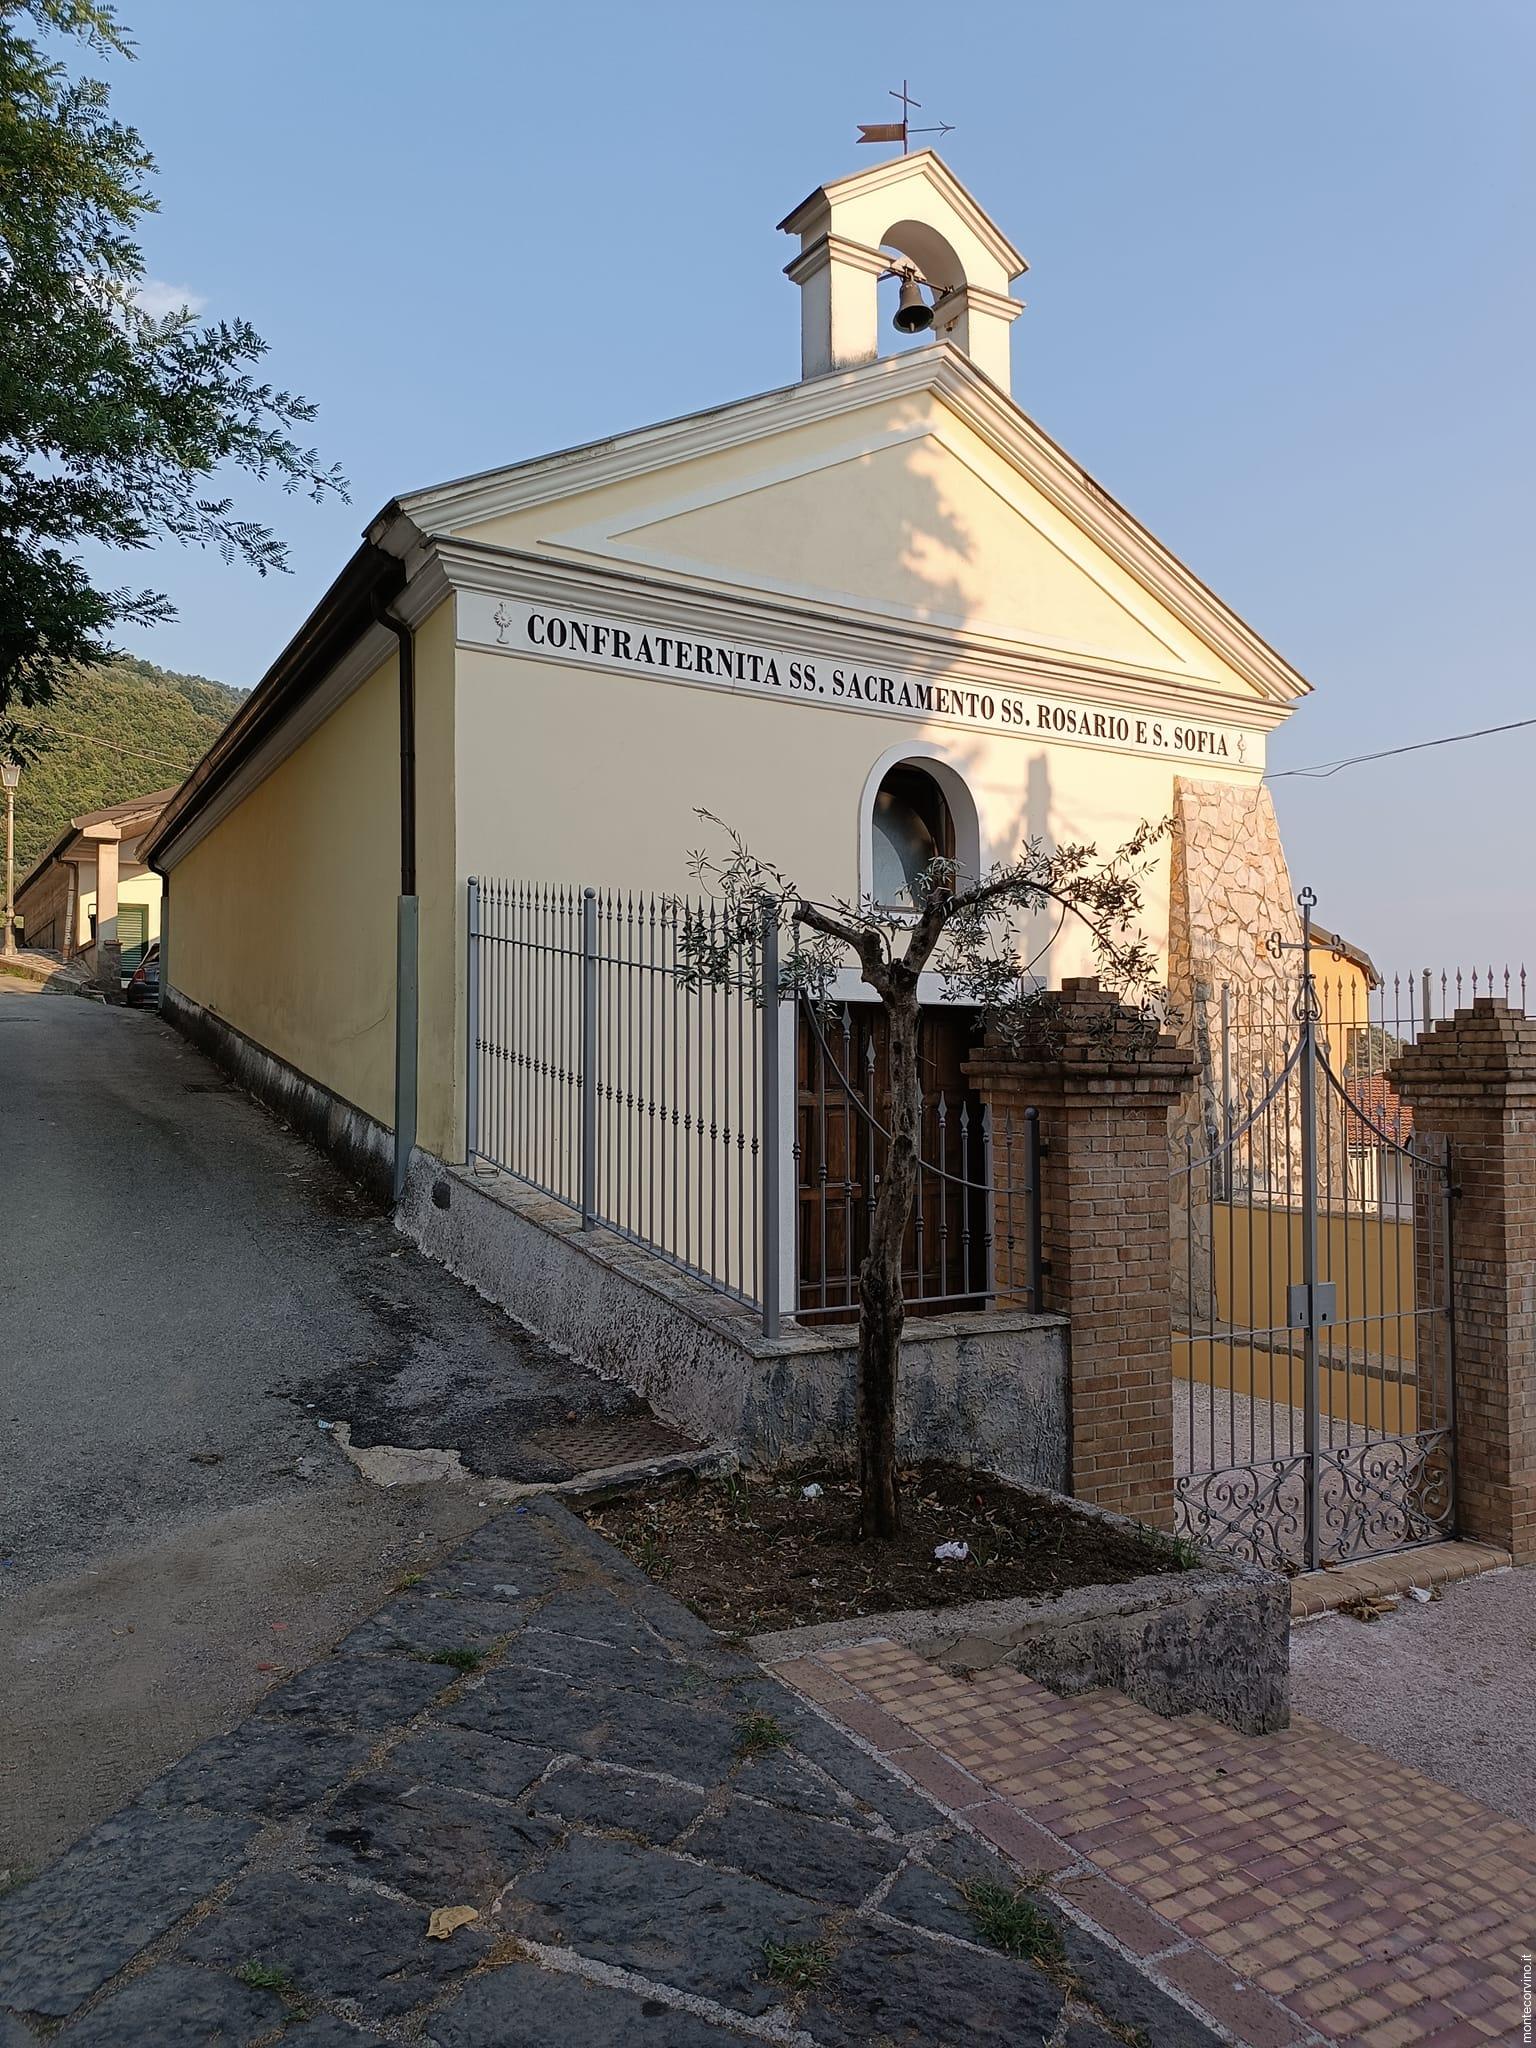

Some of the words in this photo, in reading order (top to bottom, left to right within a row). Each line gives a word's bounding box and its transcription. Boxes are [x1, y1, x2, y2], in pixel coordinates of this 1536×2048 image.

[527, 614, 782, 686] CONFRATERNITA
[789, 662, 825, 694] SS.
[832, 669, 994, 720] SACRAMENTO
[1001, 699, 1030, 727] SS.
[1037, 704, 1129, 742] ROSARIO
[1135, 721, 1148, 744] E
[1153, 724, 1168, 748] S.
[1174, 727, 1229, 757] SOFIA
